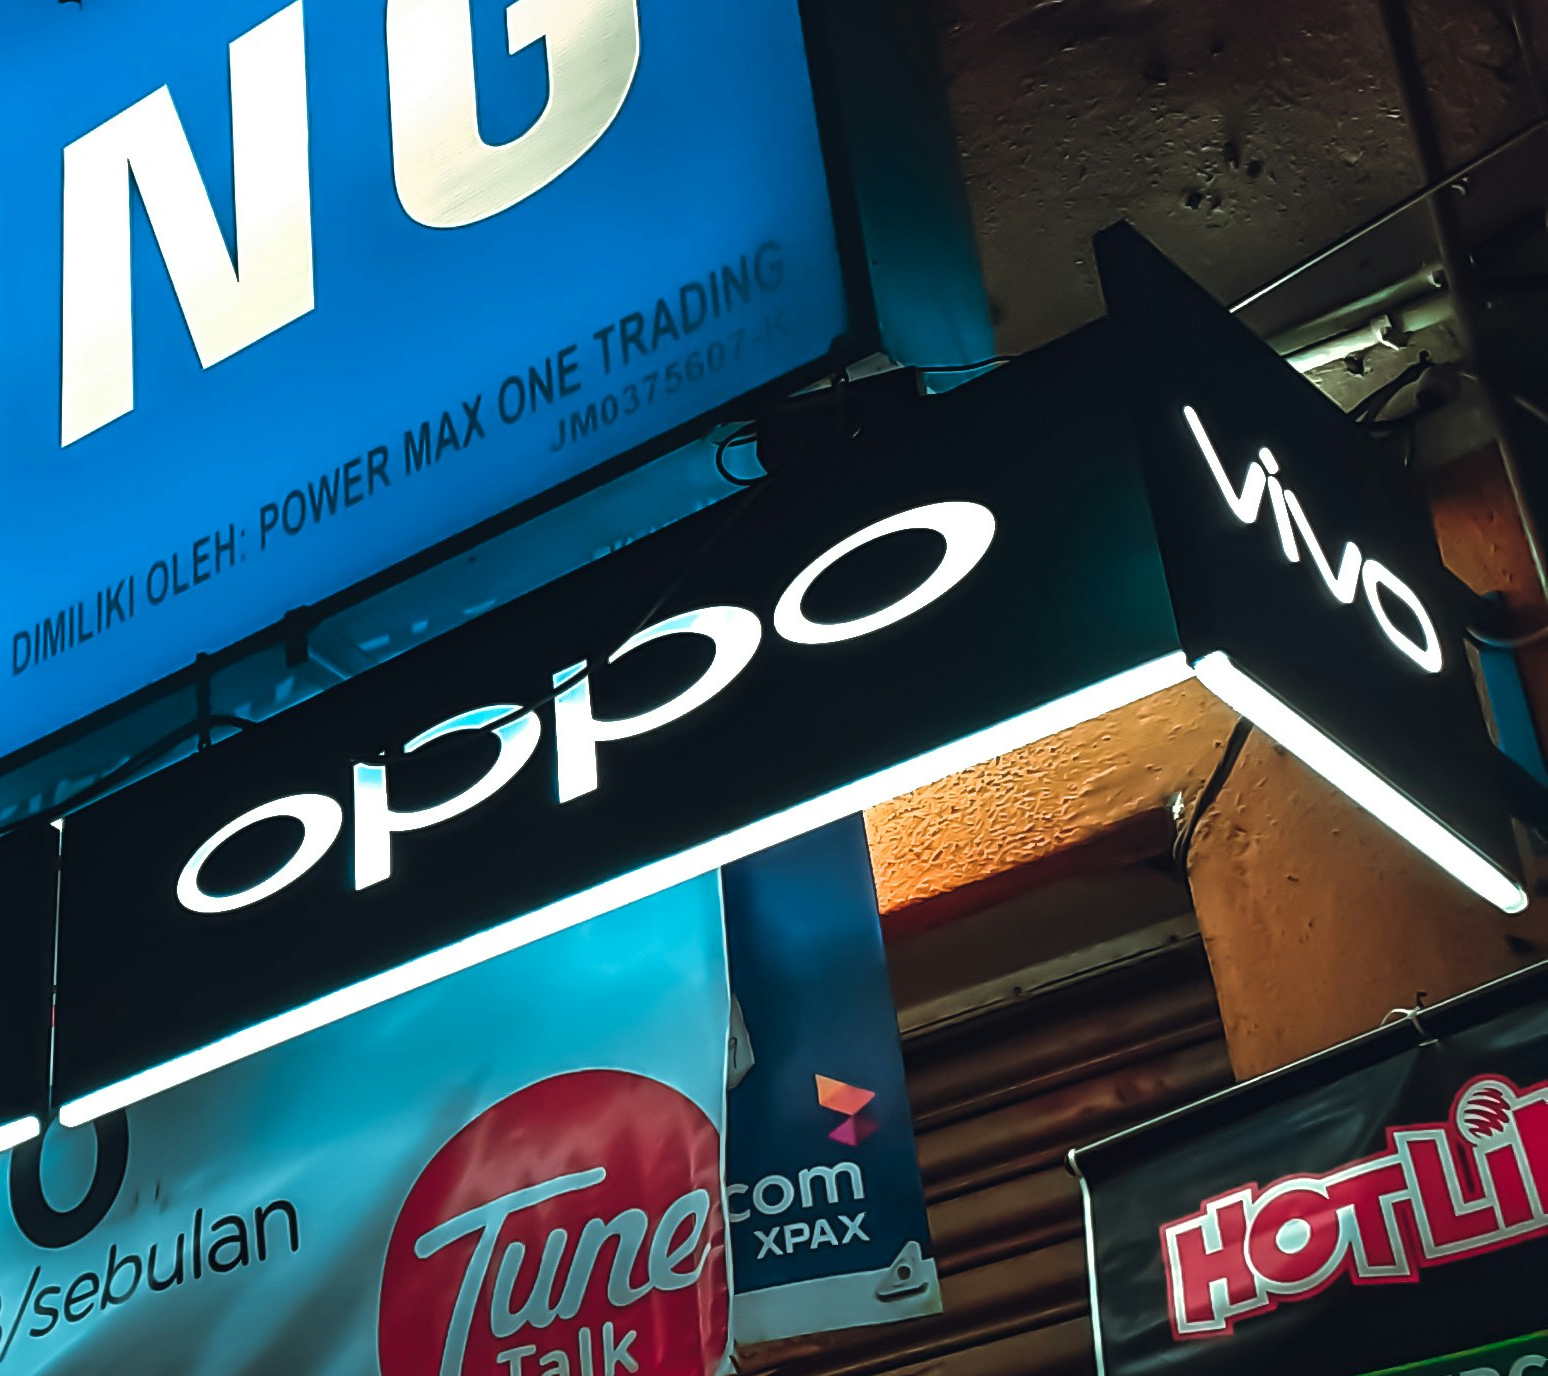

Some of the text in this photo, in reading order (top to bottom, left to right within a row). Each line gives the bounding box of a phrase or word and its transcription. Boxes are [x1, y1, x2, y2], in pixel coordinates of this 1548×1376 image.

[12, 239, 786, 677] DIMILIKI OLEH: POWER MAX ONE TRADING
[1183, 404, 1444, 674] vivo
[175, 500, 996, 913] oppo
[753, 1211, 871, 1261] XPAX
